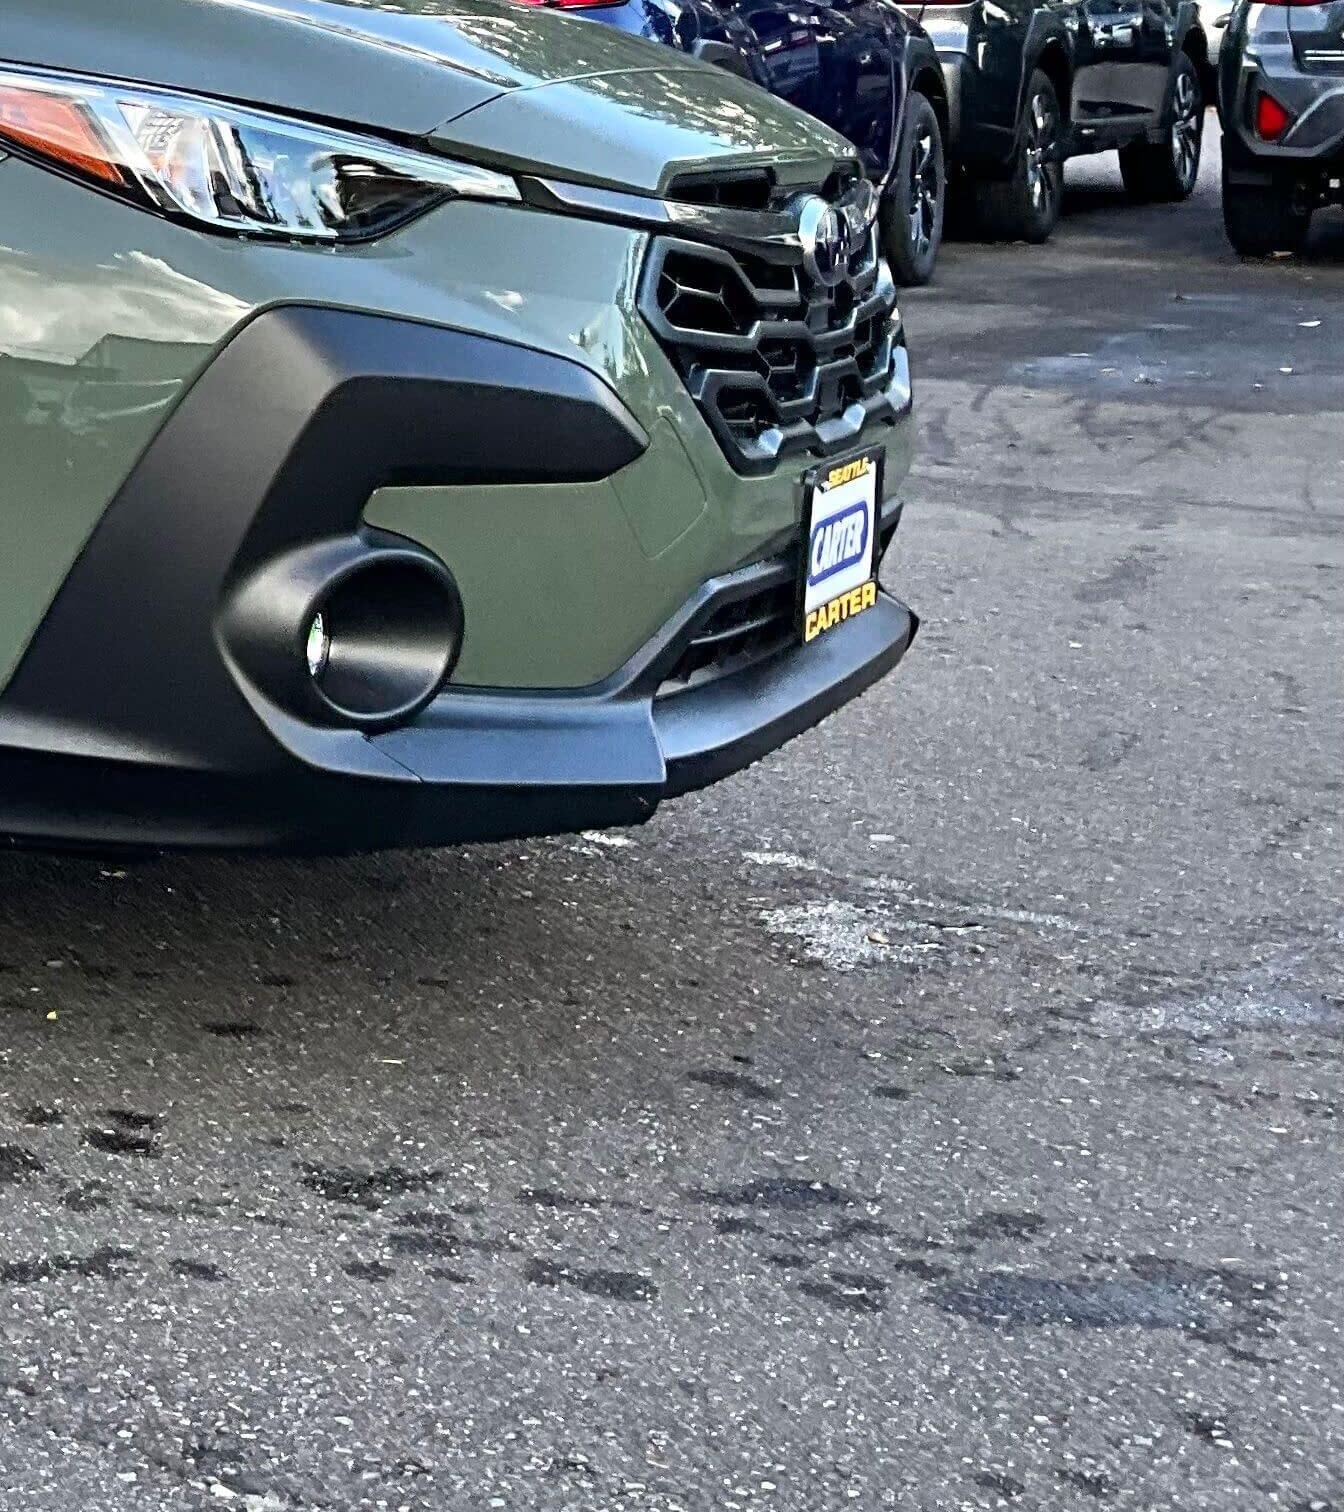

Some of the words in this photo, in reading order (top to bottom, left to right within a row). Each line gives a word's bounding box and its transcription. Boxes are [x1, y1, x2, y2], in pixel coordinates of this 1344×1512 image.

[828, 457, 869, 486] SEATTLE
[811, 510, 865, 576] CARTER
[805, 582, 876, 642] CARTER
